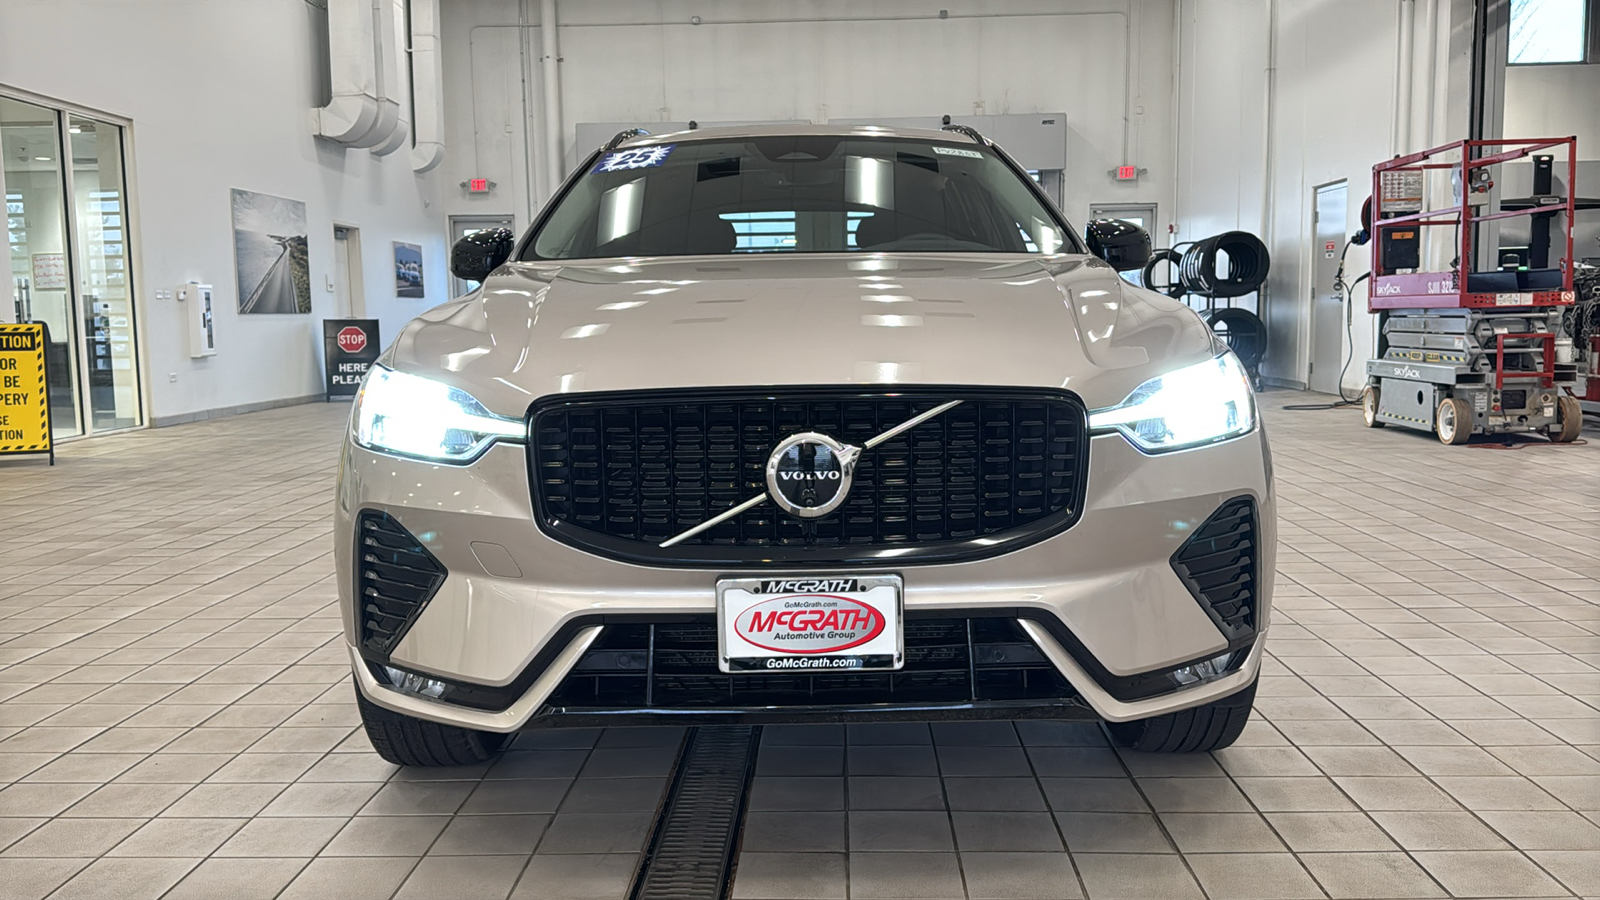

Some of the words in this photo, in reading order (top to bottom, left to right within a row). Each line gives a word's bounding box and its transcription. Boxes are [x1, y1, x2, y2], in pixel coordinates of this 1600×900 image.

[612, 151, 654, 166] 25
[1377, 282, 1401, 295] SKYJACK
[0, 335, 31, 348] TION
[340, 334, 365, 345] STOP
[338, 362, 368, 373] HERE
[1393, 366, 1420, 378] SKYJACK
[4, 375, 21, 388] BE
[779, 470, 840, 480] VOLVO
[784, 601, 838, 609] GoMcGrath.com
[774, 632, 826, 641] Automotive
[827, 631, 856, 640] Group
[766, 657, 857, 669] GoMcGrath.com
